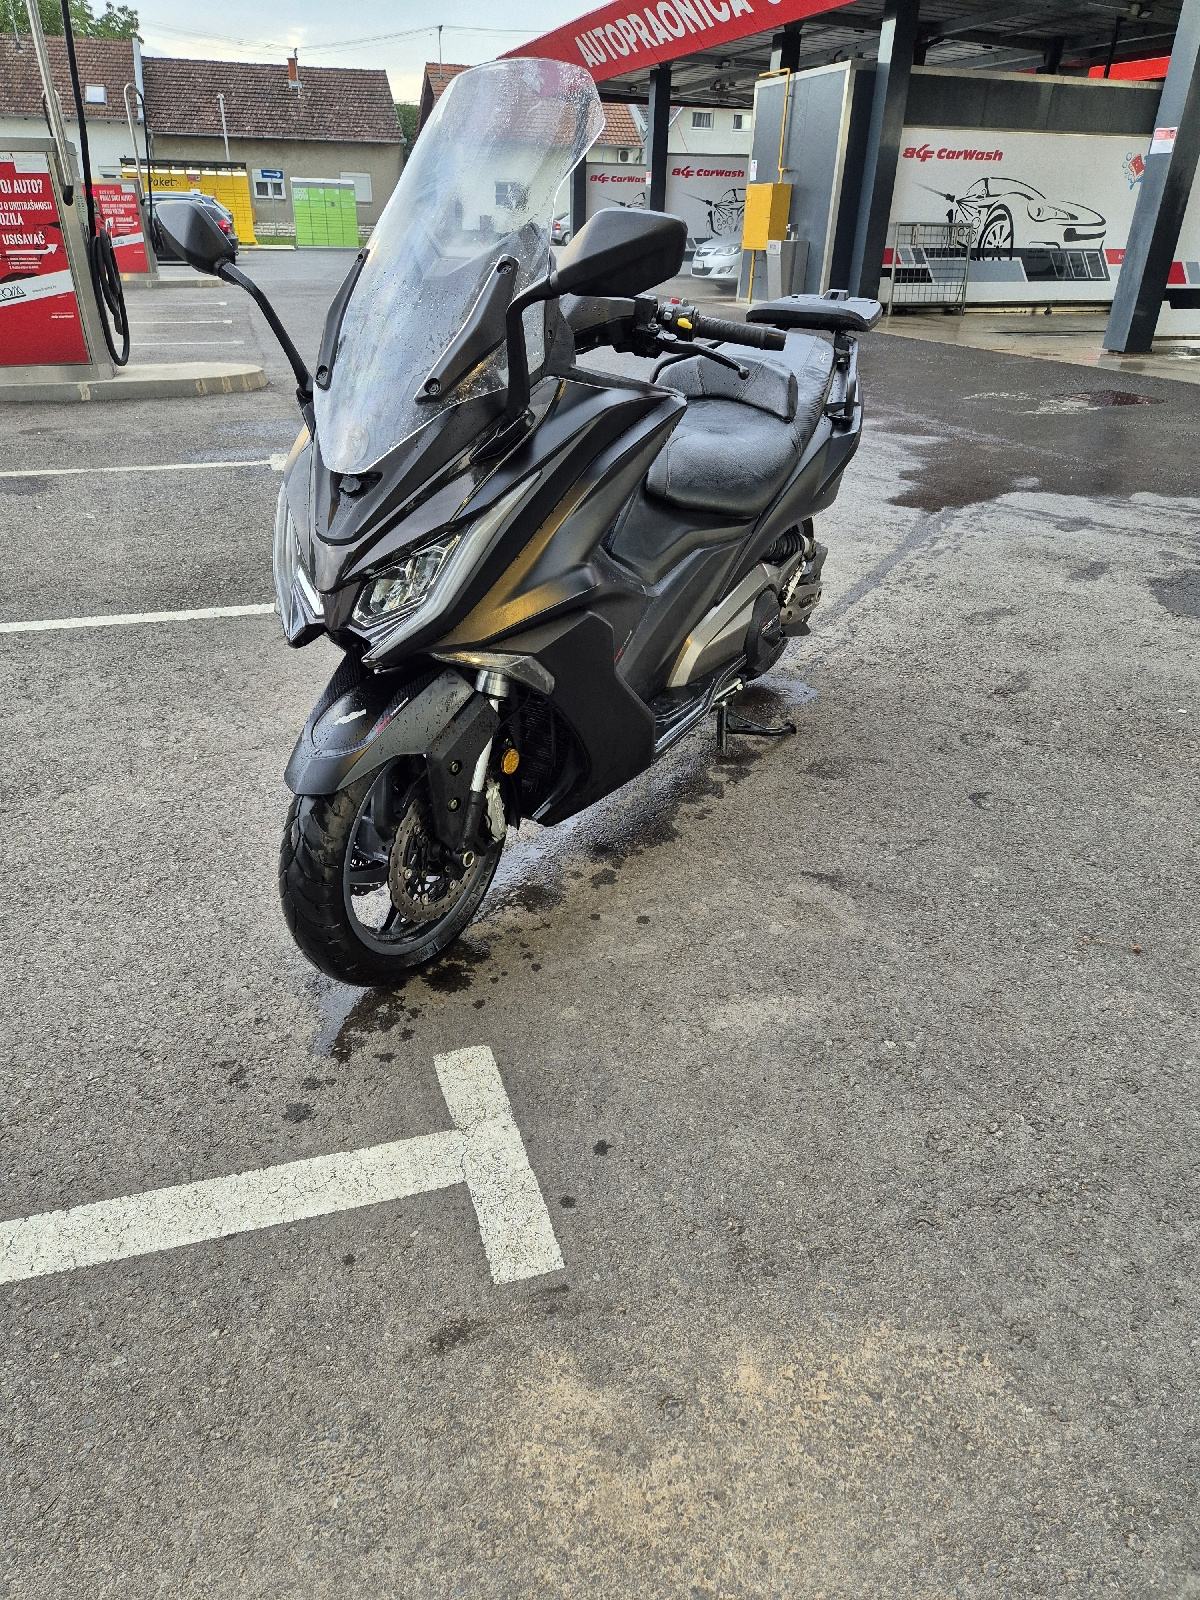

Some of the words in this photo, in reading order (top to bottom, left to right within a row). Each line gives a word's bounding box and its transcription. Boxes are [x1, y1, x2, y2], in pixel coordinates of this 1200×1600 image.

[936, 147, 1003, 161] CarWash
[610, 175, 646, 183] CarWas
[696, 168, 745, 178] CarWash
[14, 179, 43, 194] AUTO?
[2, 231, 45, 245] USISAVAČ
